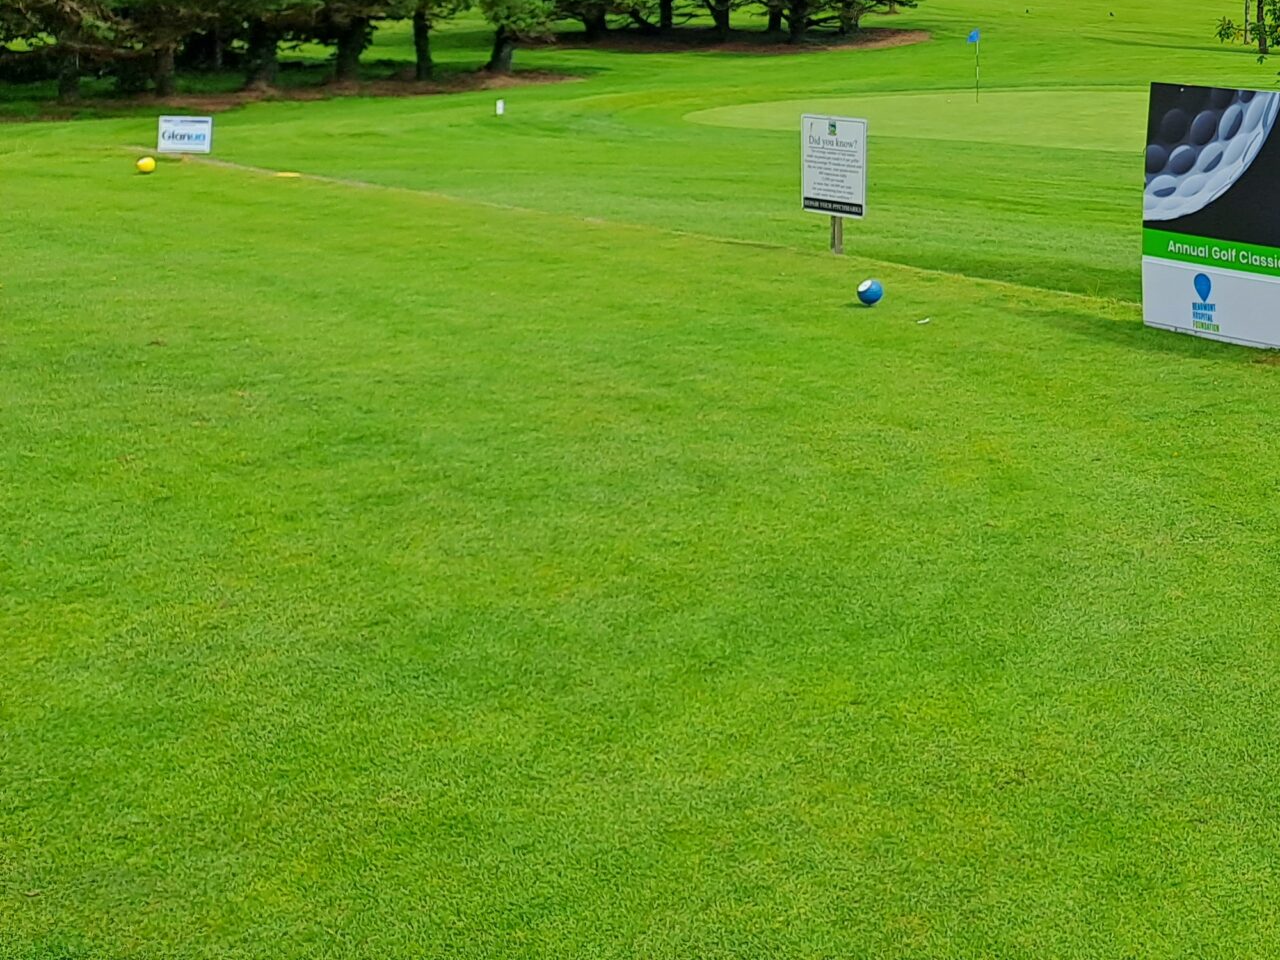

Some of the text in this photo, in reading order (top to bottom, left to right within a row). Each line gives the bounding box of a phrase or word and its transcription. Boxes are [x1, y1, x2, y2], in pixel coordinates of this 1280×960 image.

[162, 129, 206, 142] Glanua
[809, 136, 858, 148] Did you know?
[1168, 240, 1209, 259] Annual
[1212, 247, 1236, 263] Golf
